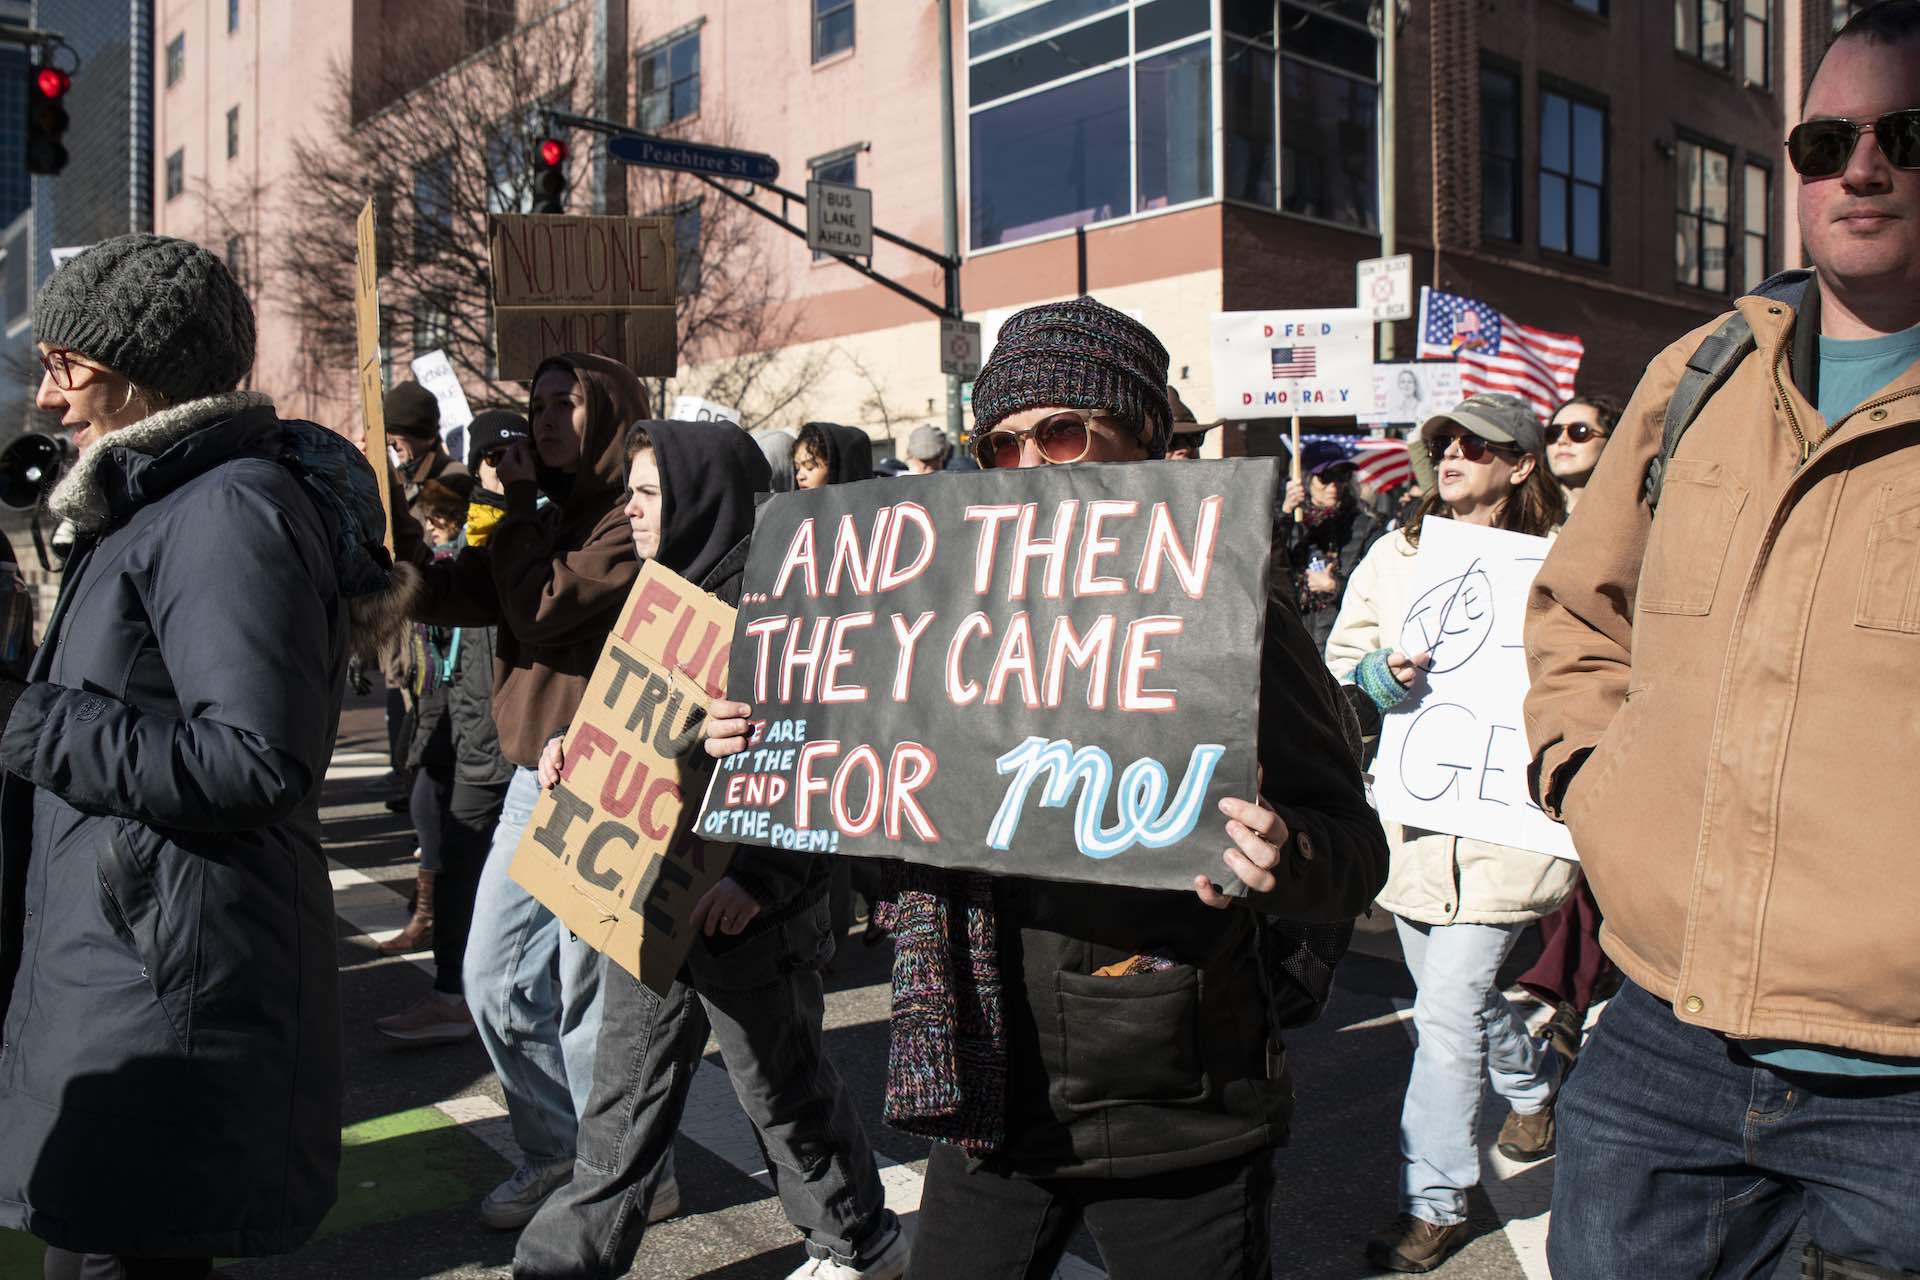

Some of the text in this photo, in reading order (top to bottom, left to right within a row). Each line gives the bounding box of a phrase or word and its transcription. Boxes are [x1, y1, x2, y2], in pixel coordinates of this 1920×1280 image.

[642, 143, 726, 171] Peachtree
[730, 156, 747, 173] St
[823, 210, 857, 229] LANE
[827, 191, 852, 208] BUS
[819, 230, 862, 248] AHEAD
[501, 223, 659, 296] NOT ONE
[539, 312, 632, 360] MORE
[1264, 323, 1332, 338] DFED
[1242, 389, 1349, 406] DMORAY
[964, 494, 1224, 602] THEN
[622, 577, 732, 700] FUC
[1408, 586, 1484, 653] ICE
[945, 610, 1185, 711] CAME
[765, 718, 807, 743] ARE
[723, 748, 796, 773] AT THE
[1400, 702, 1548, 814] GE
[725, 771, 789, 808] END
[794, 739, 940, 842] FOR
[704, 809, 840, 853] OF THE POEM!
